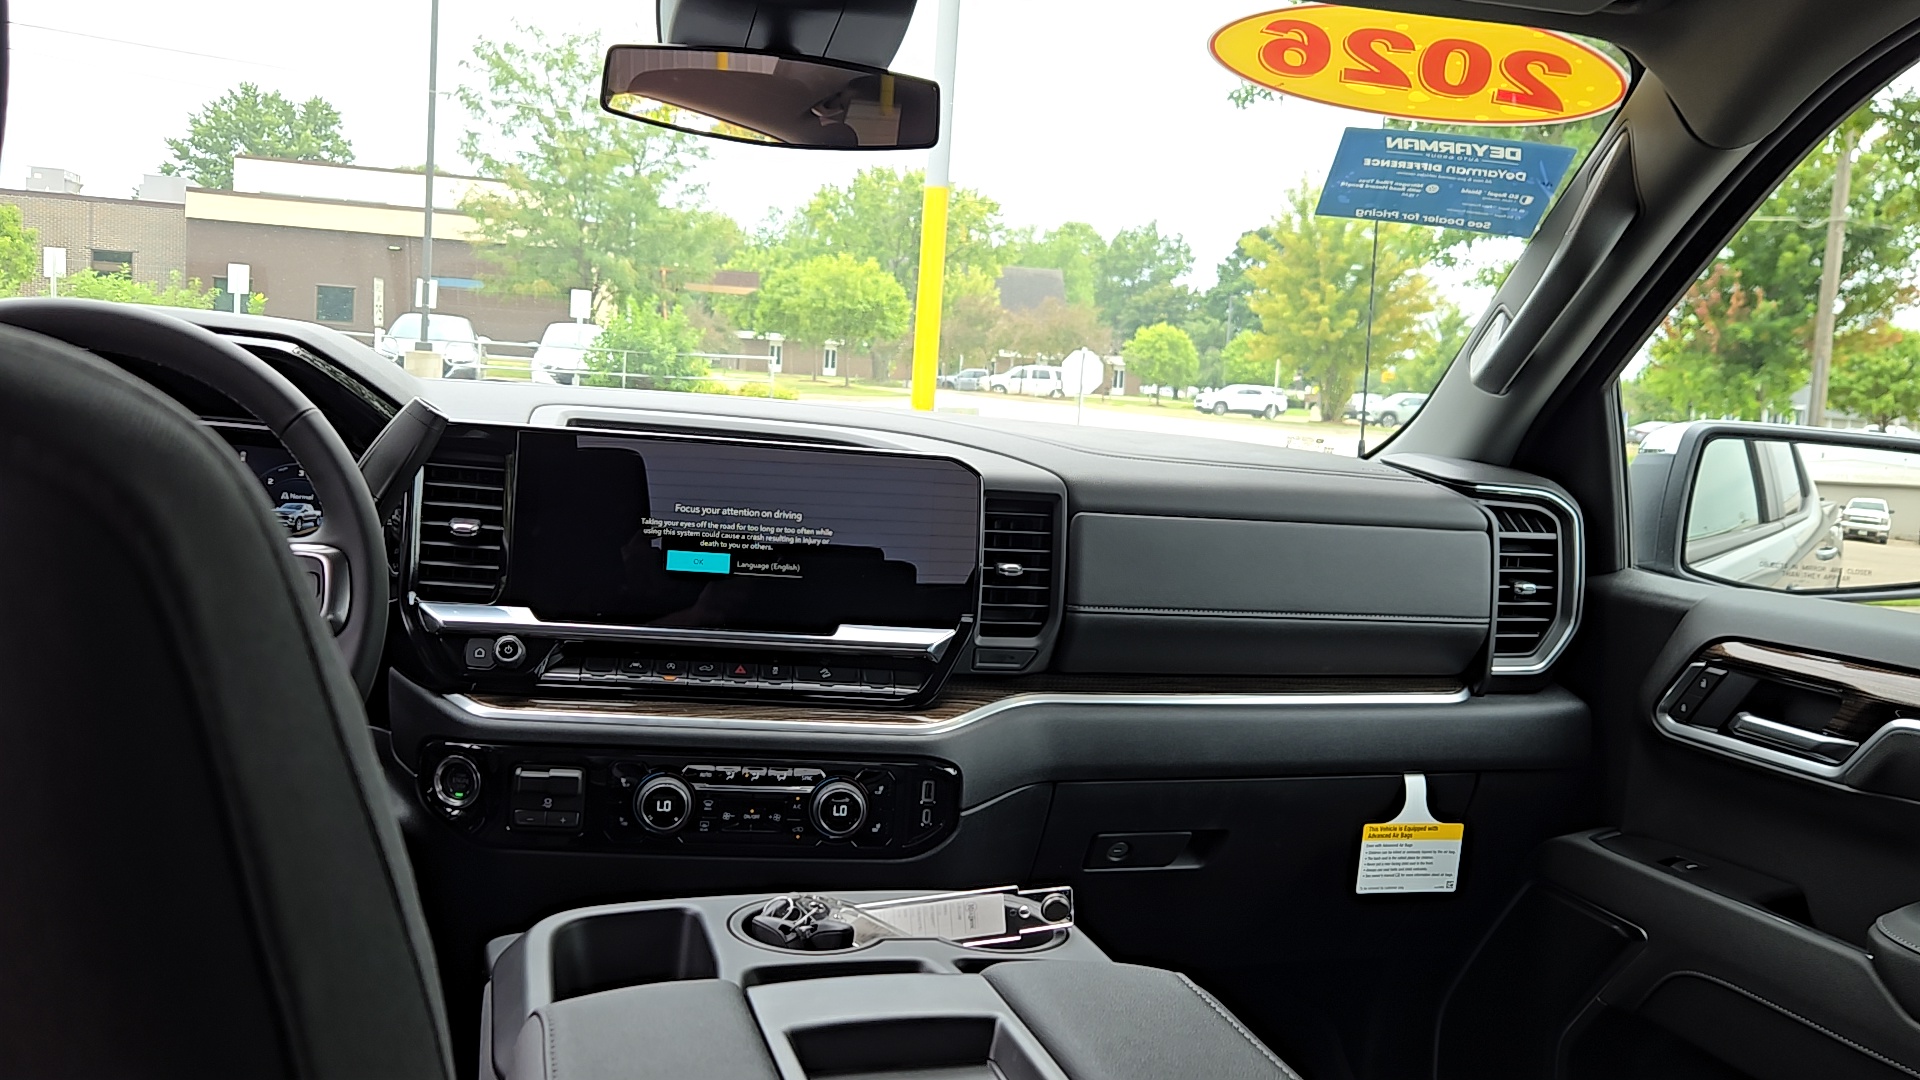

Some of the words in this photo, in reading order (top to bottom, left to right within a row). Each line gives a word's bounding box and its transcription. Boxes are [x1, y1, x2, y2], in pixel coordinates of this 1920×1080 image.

[675, 503, 700, 513] Focus
[701, 506, 720, 516] your
[722, 507, 760, 517] attention
[761, 510, 772, 518] on
[774, 509, 803, 522] driving
[641, 517, 663, 527] Taking
[664, 520, 679, 528] your
[696, 520, 707, 528] off
[708, 521, 718, 529] the
[720, 522, 735, 530] road
[760, 524, 775, 534] long
[784, 526, 795, 534] too
[797, 526, 814, 535] often
[815, 528, 833, 536] while
[643, 527, 662, 536] using
[677, 529, 700, 537] system
[746, 533, 765, 541] crash
[765, 534, 794, 544] resulting
[803, 536, 821, 546] injury
[750, 541, 773, 550] others.
[737, 561, 769, 570] Language
[771, 562, 800, 572] (English)
[1847, 567, 1872, 576] CLOSER
[656, 800, 671, 812] LO
[833, 804, 848, 816] LO
